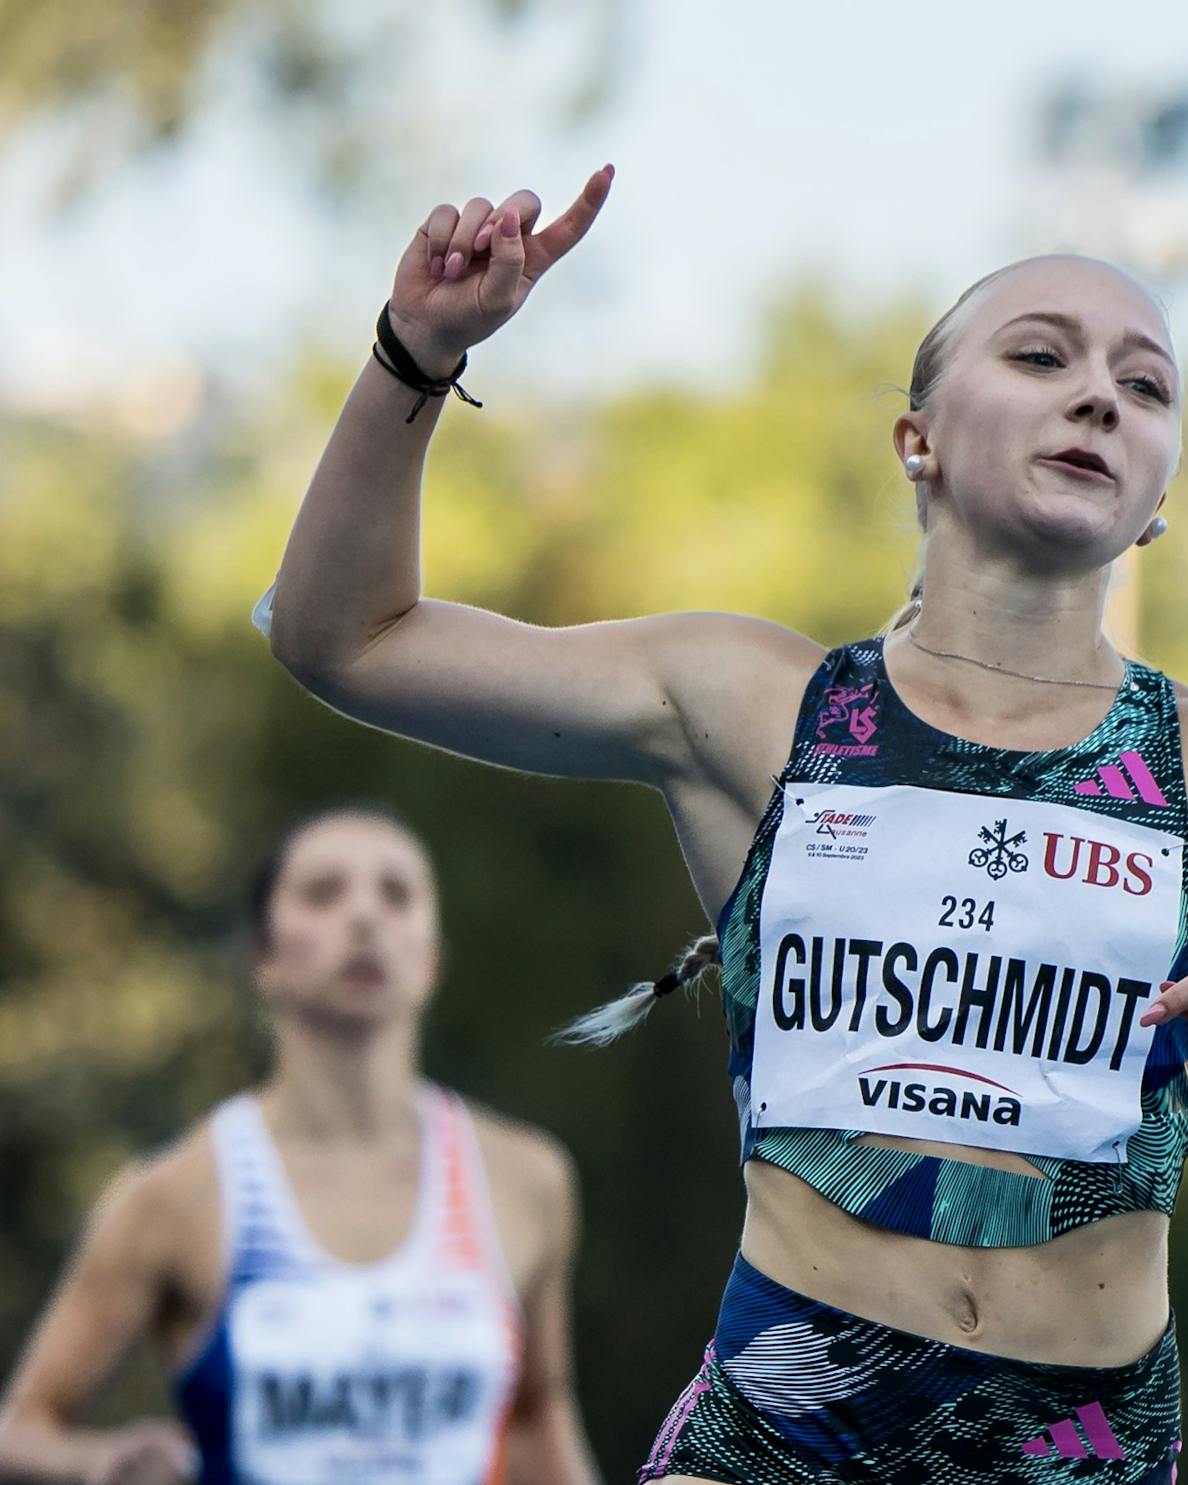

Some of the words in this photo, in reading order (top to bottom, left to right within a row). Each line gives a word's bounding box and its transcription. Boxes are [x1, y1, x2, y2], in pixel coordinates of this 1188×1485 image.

[1042, 832, 1153, 896] UBS
[938, 895, 995, 931] 234
[772, 933, 1152, 1072] GUTSCHMIDT
